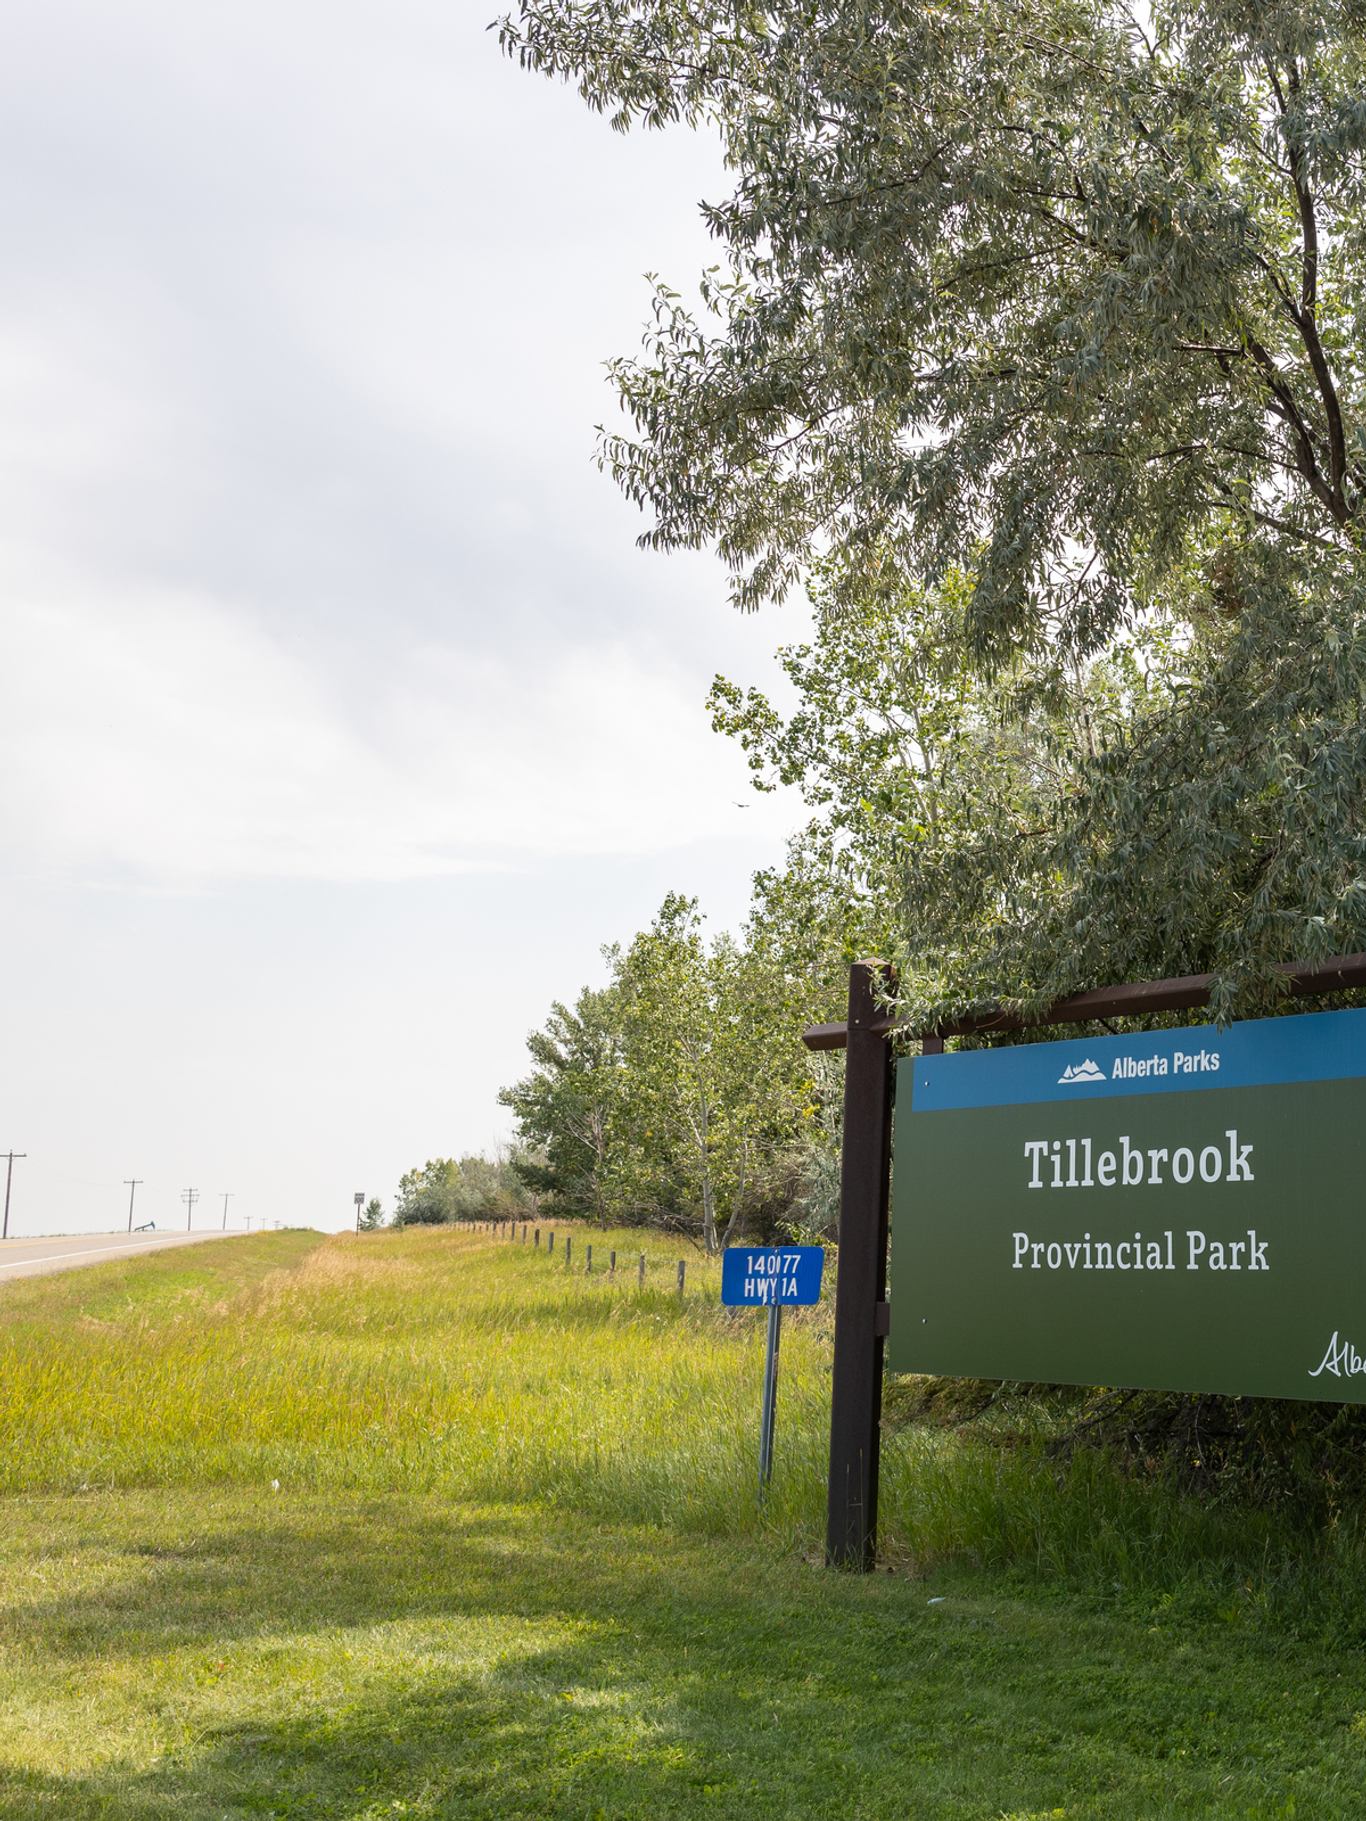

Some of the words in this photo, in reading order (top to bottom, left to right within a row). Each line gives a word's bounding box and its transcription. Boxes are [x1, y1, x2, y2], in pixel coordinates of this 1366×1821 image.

[1112, 1055, 1168, 1079] Alberta
[1173, 1050, 1220, 1074] Parks
[1024, 1130, 1255, 1188] Tillebrook
[1012, 1231, 1176, 1269] Provincial
[1186, 1230, 1270, 1270] Park
[744, 1278, 778, 1297] HWY
[781, 1277, 798, 1297] 1A
